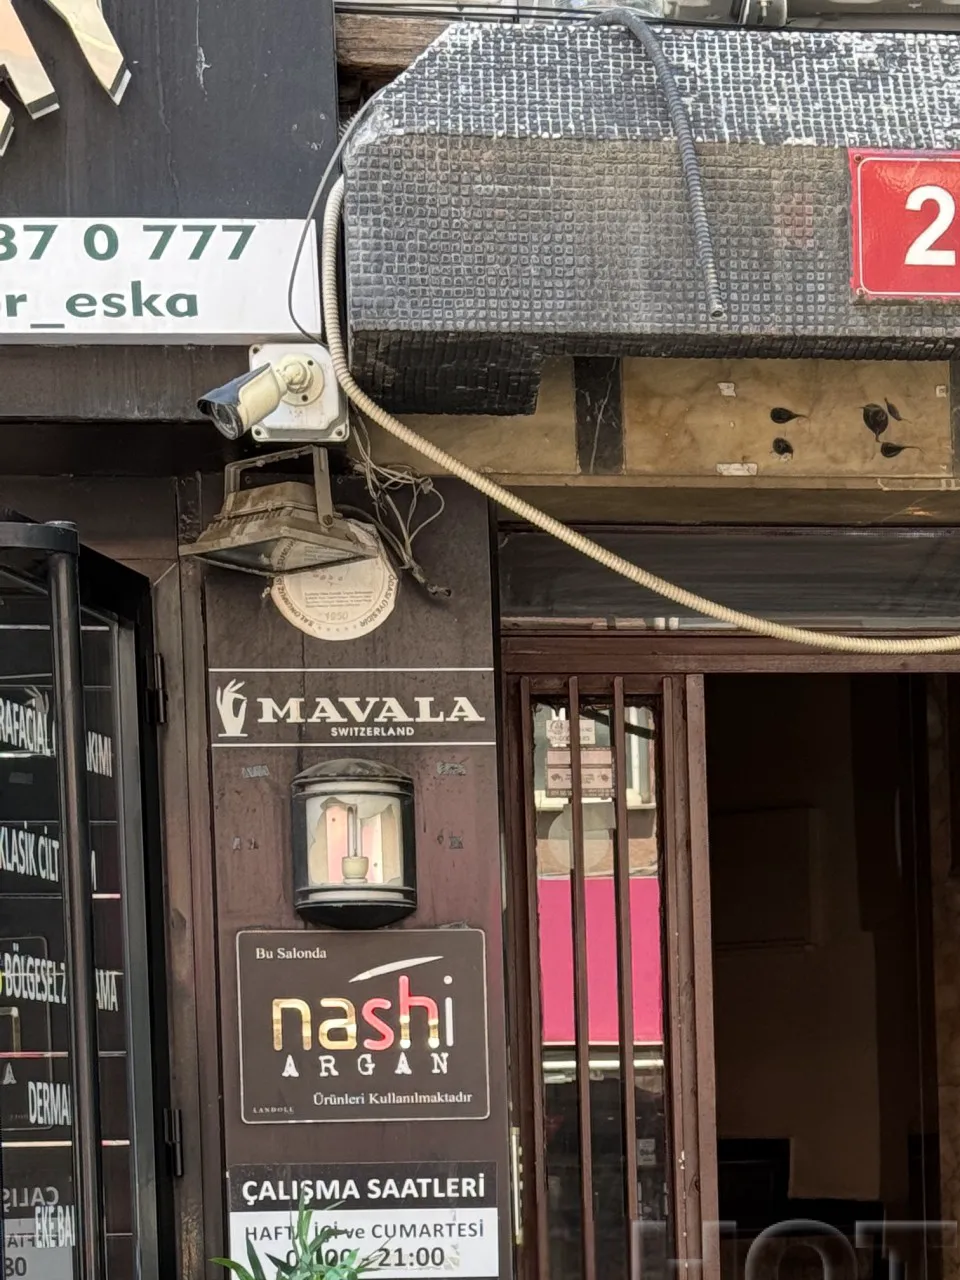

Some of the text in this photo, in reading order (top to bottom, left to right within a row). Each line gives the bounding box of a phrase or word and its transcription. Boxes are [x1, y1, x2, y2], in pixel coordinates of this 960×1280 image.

[84, 225, 119, 261] 0
[143, 225, 256, 260] 777
[256, 696, 486, 723] MAVALA
[331, 726, 415, 738] SWITZERLAND
[255, 947, 327, 960] Bu Salonda
[4, 943, 60, 1004] BÖLGESEL
[272, 975, 454, 1050] nashi
[281, 1052, 450, 1077] ARGAN
[313, 1090, 473, 1106] Ürünleri Kullanılmaktadır
[241, 1173, 485, 1206] ÇALIŞMA SAATLERİ
[246, 1226, 299, 1242] HAFT
[345, 1227, 365, 1240] ve
[371, 1218, 485, 1239] CUMARTESİ
[378, 1247, 445, 1267] 21:00
